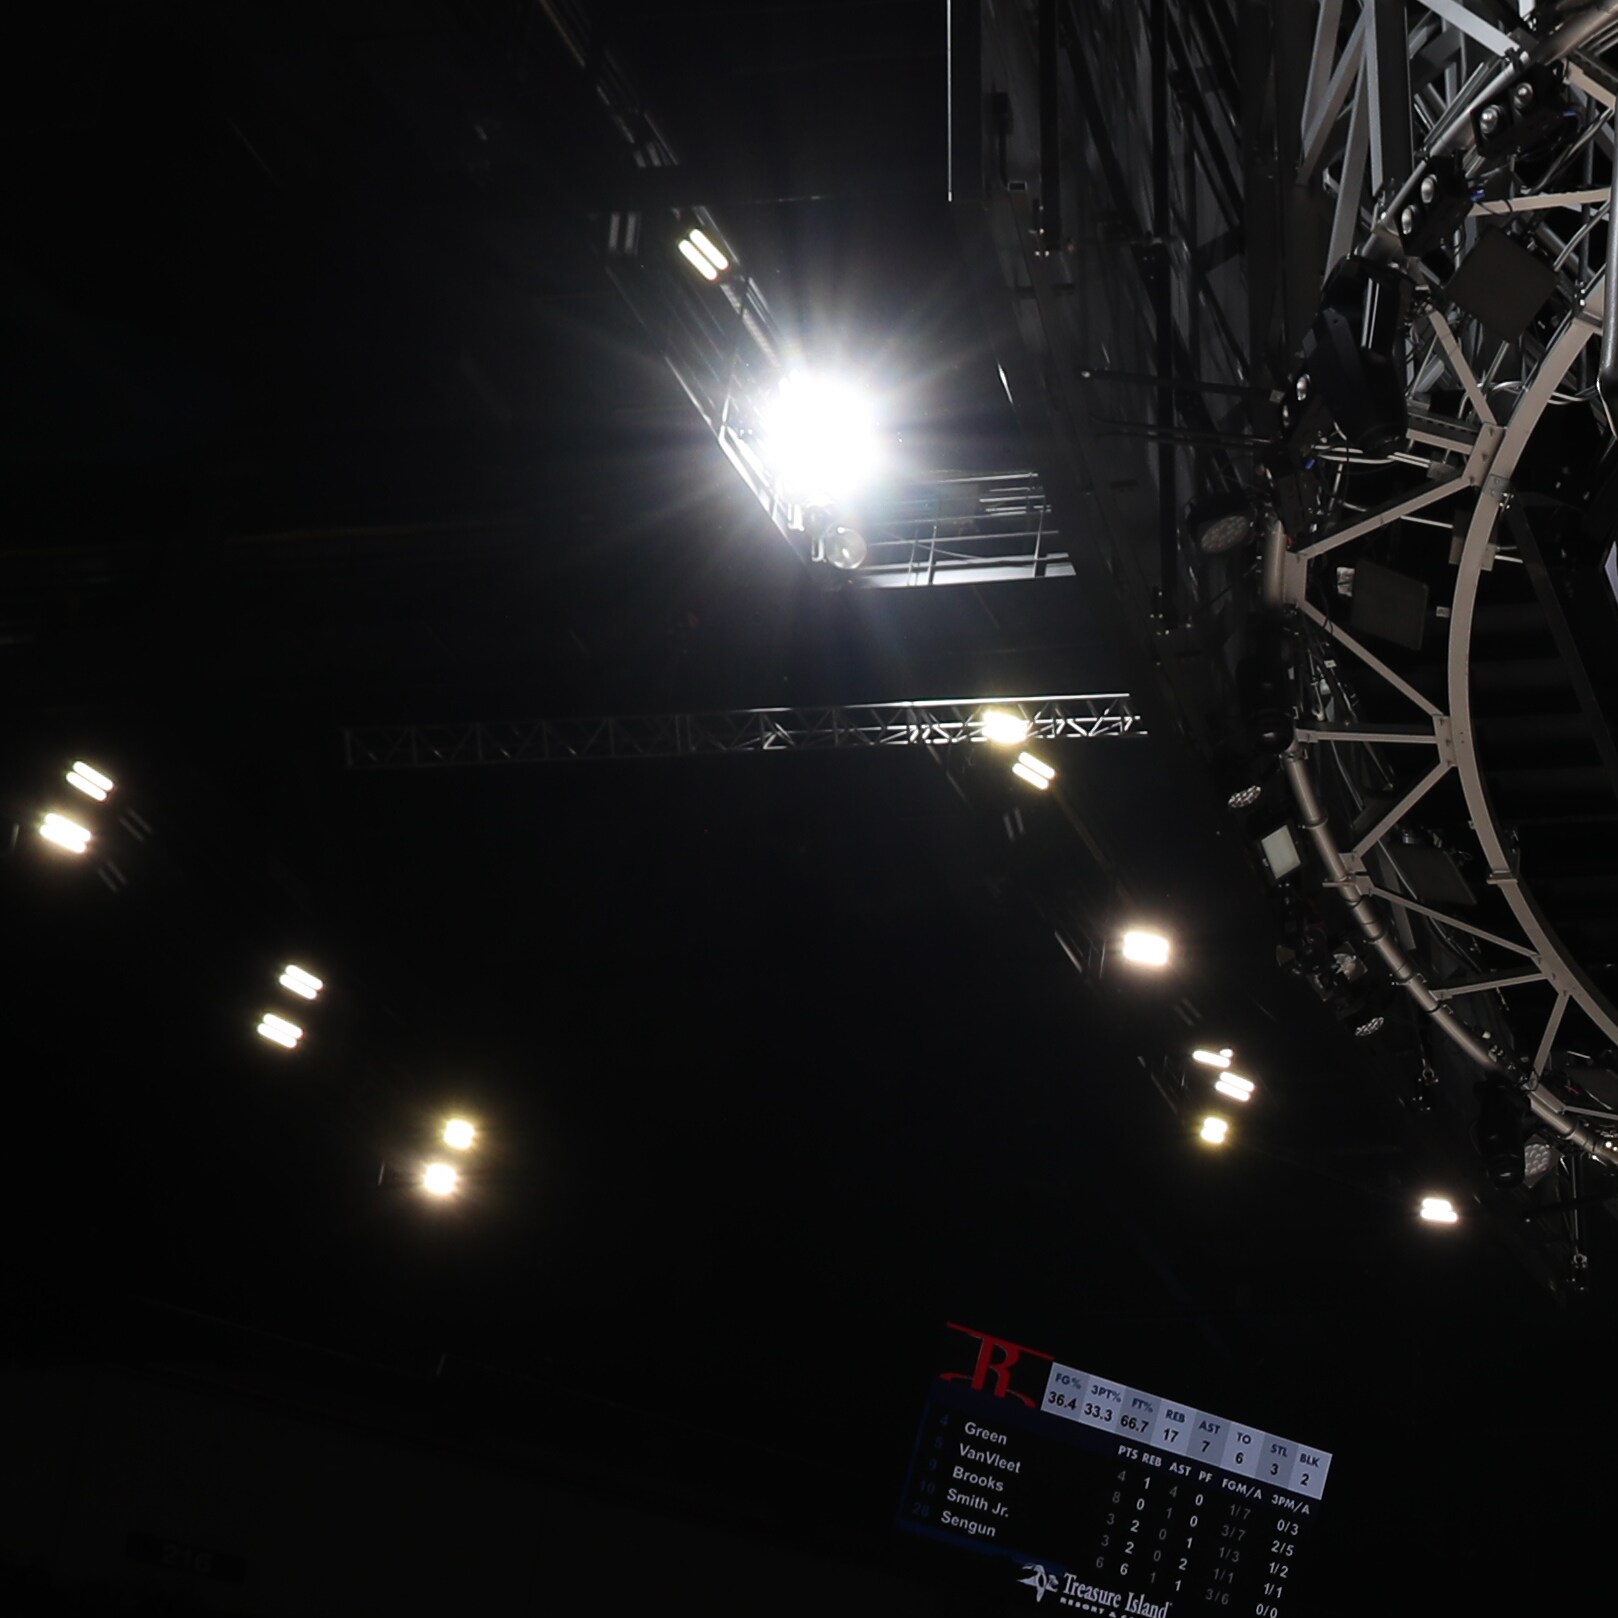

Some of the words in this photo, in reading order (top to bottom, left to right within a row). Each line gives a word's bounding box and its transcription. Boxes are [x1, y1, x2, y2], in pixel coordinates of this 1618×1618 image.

[964, 1421, 1008, 1445] Green
[1055, 1372, 1081, 1389] FG%
[1091, 1385, 1121, 1403] 3PT%
[1132, 1397, 1153, 1413] FT%
[1165, 1409, 1186, 1424] REB
[1198, 1421, 1220, 1435] AST
[1237, 1433, 1251, 1444] TO
[1271, 1443, 1288, 1457] STL
[1300, 1453, 1320, 1467] BLK
[1047, 1391, 1077, 1411] 36.4
[1084, 1403, 1113, 1422] 33.3
[1120, 1414, 1149, 1433] 66.7
[1163, 1428, 1179, 1443] 17
[1201, 1441, 1210, 1453] 7
[1235, 1452, 1245, 1464] 6
[1270, 1463, 1279, 1475] 3
[1300, 1474, 1309, 1486] 2
[959, 1442, 1021, 1473] VanVleet
[952, 1465, 1004, 1492] Brooks
[1118, 1445, 1138, 1460] PTS
[1141, 1453, 1162, 1468] REB
[1169, 1462, 1192, 1477] AST
[1199, 1470, 1213, 1483] PF
[1222, 1478, 1262, 1500] FGM/A
[1271, 1494, 1310, 1515] 3PM/A
[946, 1487, 988, 1511] Smith
[991, 1502, 1009, 1518] Jr.
[941, 1510, 996, 1537] Sengun
[1063, 1572, 1122, 1608] Treasure
